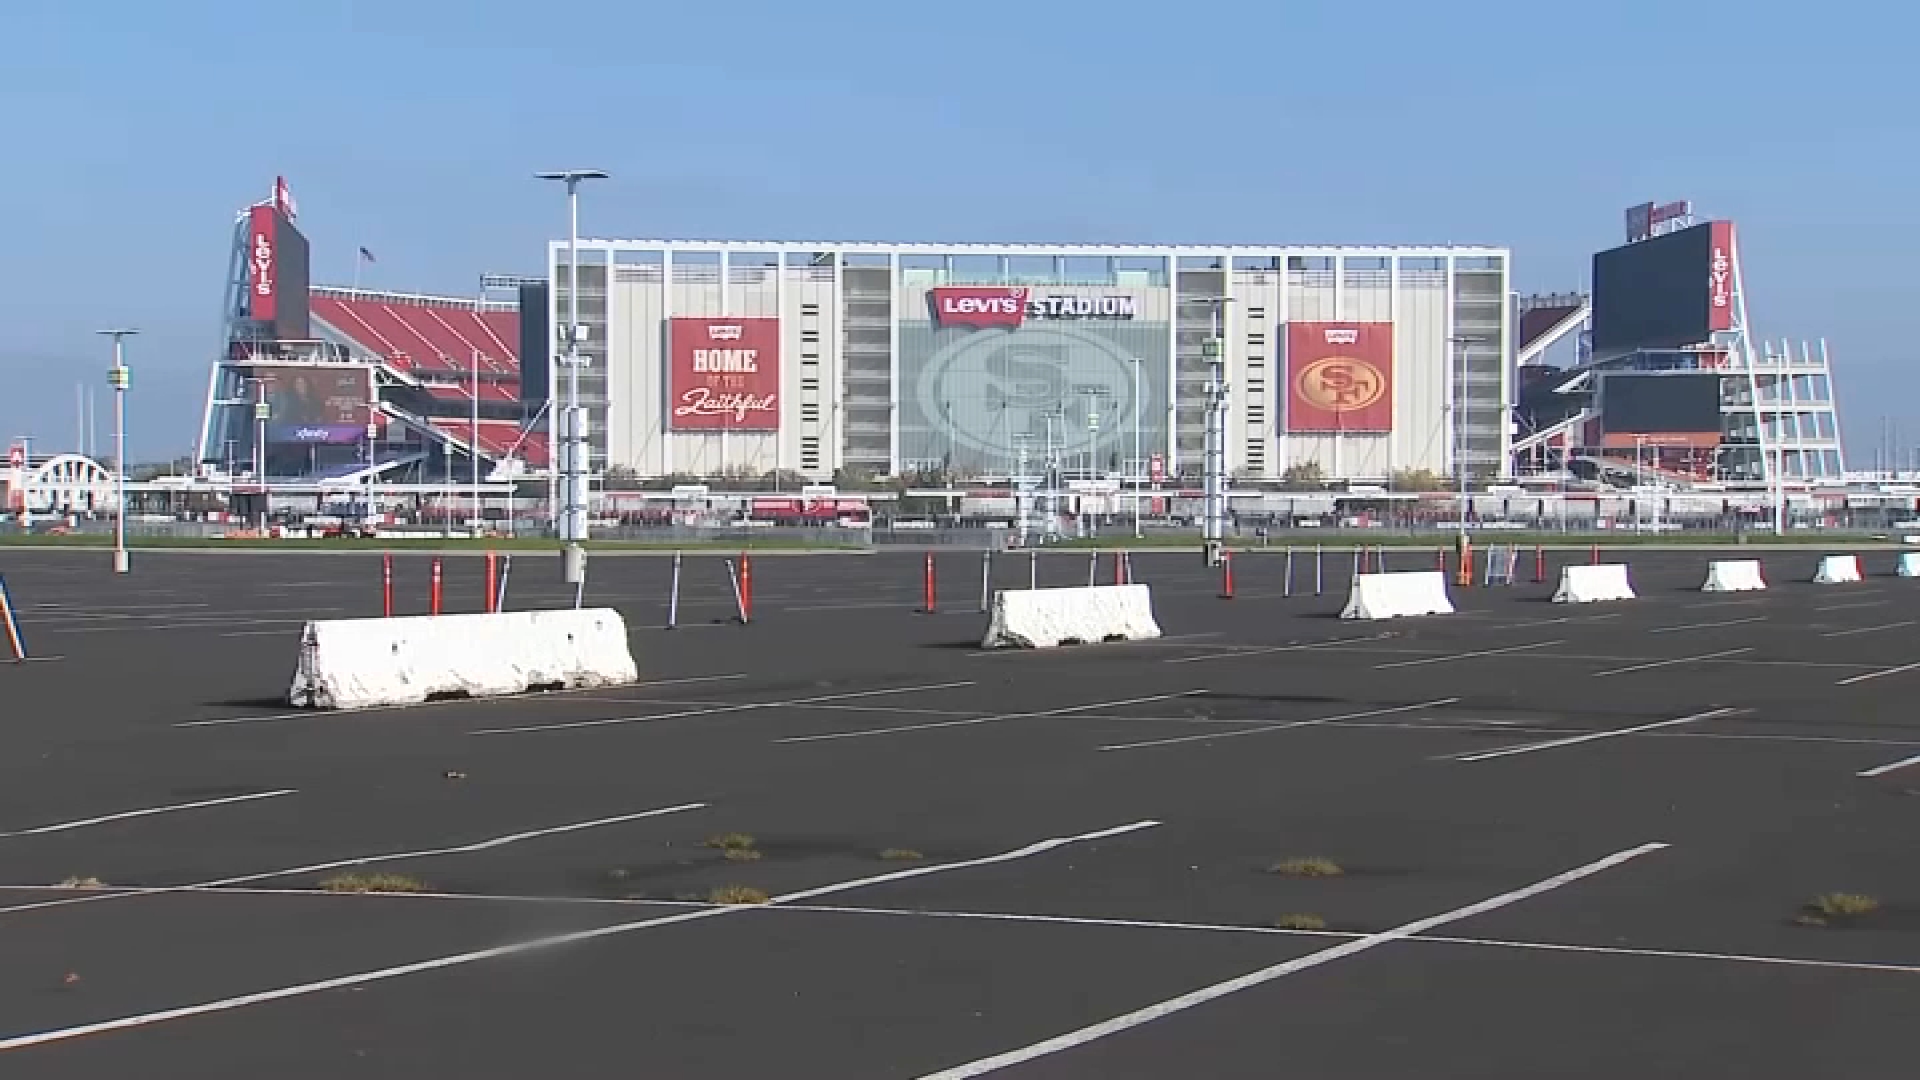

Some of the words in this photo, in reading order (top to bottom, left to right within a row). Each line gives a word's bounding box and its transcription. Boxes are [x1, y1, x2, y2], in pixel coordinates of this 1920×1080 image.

[1032, 296, 1136, 317] STADIUM
[693, 350, 757, 372] HOME
[675, 388, 776, 422] Faithful
